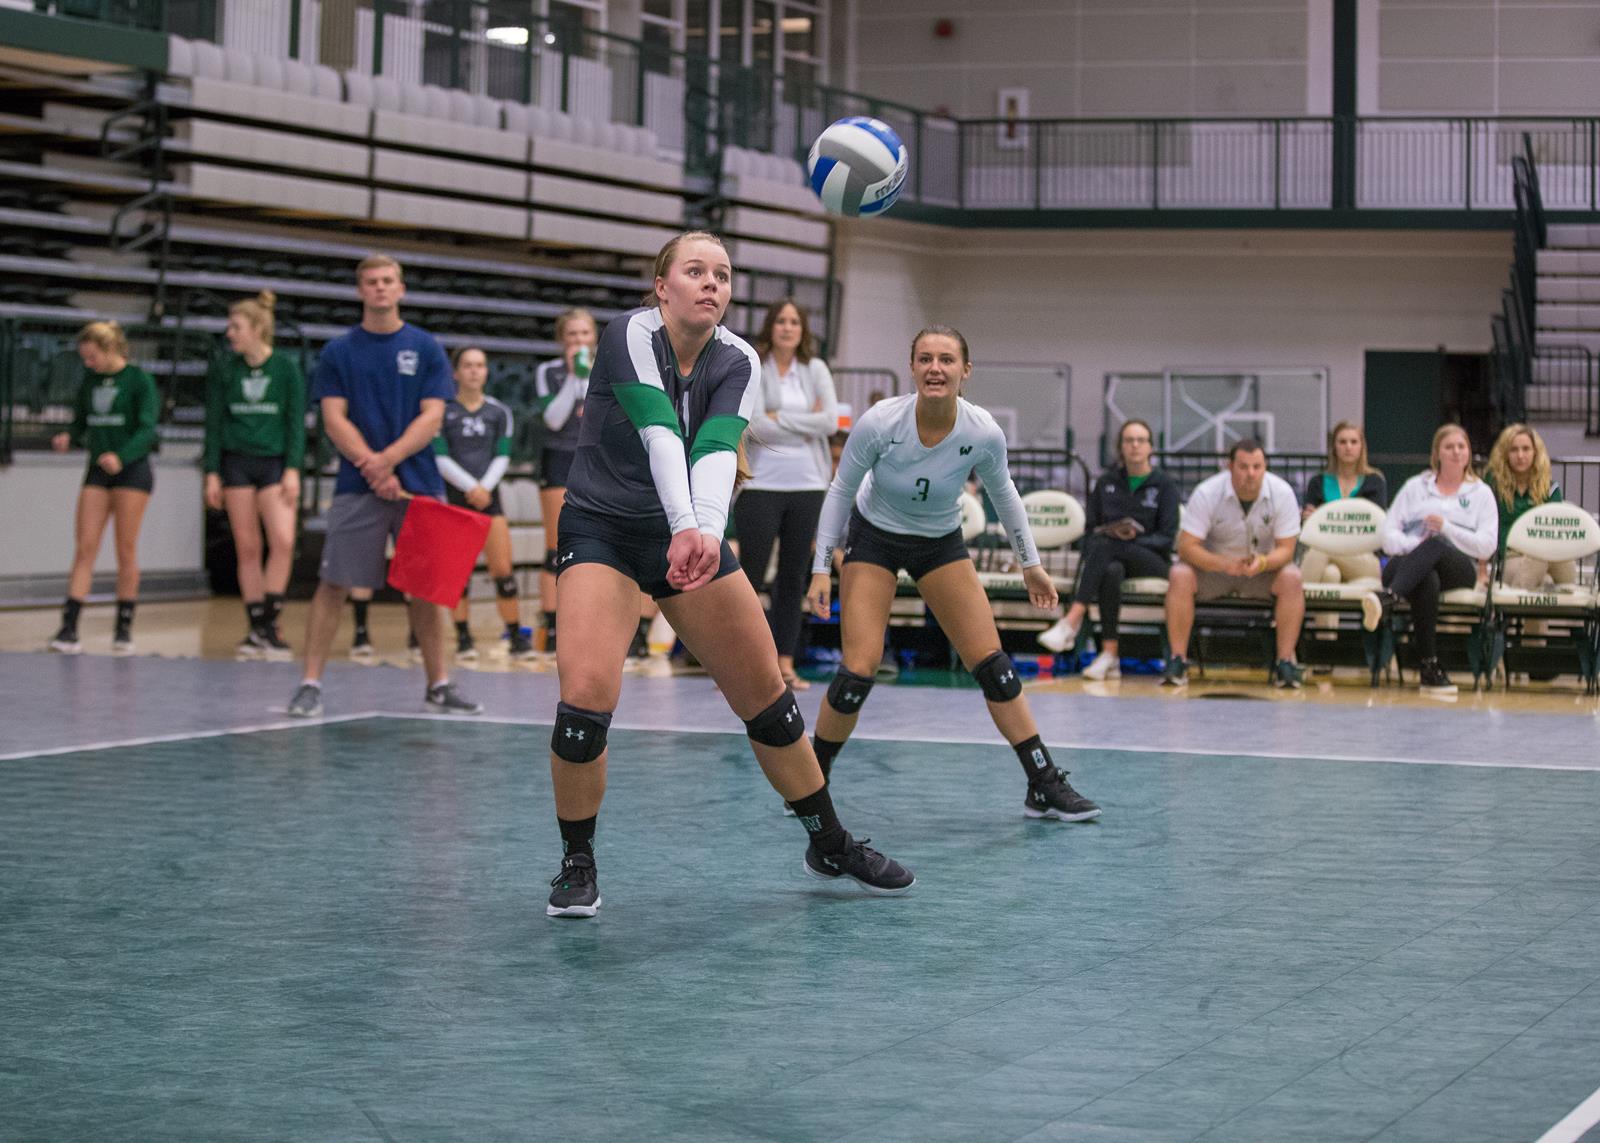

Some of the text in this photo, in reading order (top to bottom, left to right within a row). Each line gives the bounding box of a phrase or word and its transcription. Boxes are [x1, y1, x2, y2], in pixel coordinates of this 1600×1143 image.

[959, 445, 973, 456] W
[911, 477, 930, 501] 3
[1327, 512, 1371, 522] ILLINOIS
[1534, 516, 1580, 527] ILLINOIS
[1318, 524, 1376, 534] WESLEYAN
[1526, 528, 1586, 540] WESLEYAN
[1519, 595, 1558, 606] TITANS
